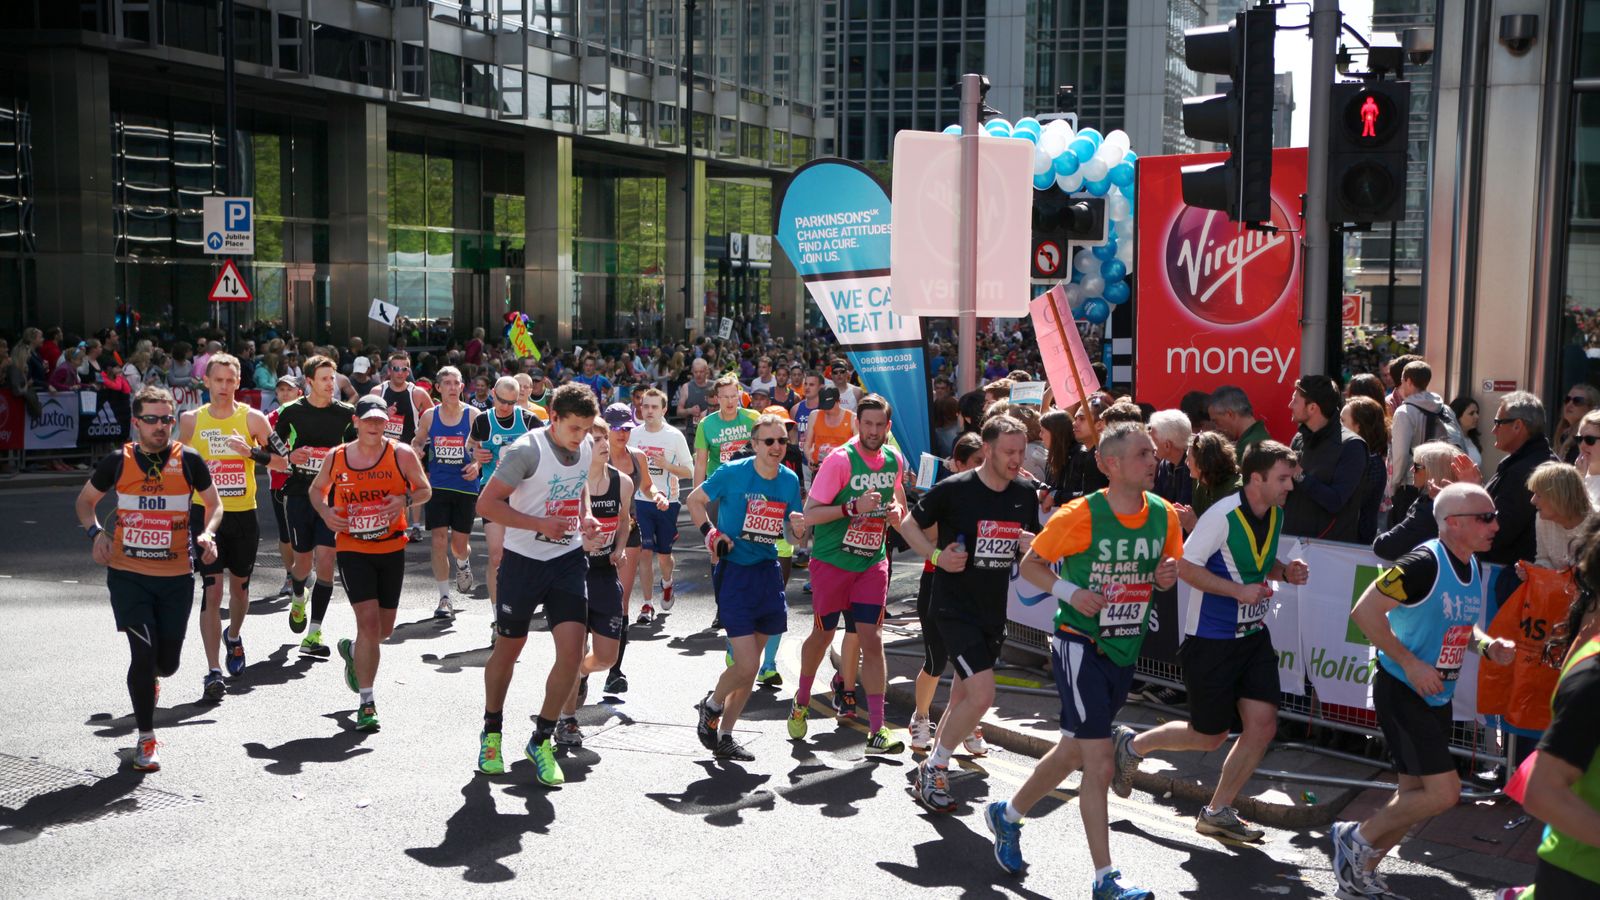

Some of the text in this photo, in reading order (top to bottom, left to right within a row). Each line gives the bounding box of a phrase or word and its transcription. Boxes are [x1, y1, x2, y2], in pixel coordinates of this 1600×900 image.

[229, 203, 246, 229] P
[795, 211, 871, 229] PARKINSON'S
[797, 228, 839, 241] CHANGE
[799, 238, 860, 253] FIND A CURE.
[800, 251, 841, 264] JOIN US.
[1177, 209, 1286, 305] Virgin
[830, 288, 863, 310] WE
[837, 311, 882, 333] BEAT
[1167, 345, 1296, 384] money
[88, 424, 122, 436] adidas
[719, 425, 748, 437] JOHN
[435, 447, 463, 456] 23724
[211, 473, 245, 486] 8895
[138, 495, 167, 510] Rob
[144, 518, 170, 527] money
[350, 515, 388, 530] 43725
[745, 515, 783, 533] 38035
[998, 526, 1021, 534] money
[125, 529, 170, 546] 47695
[845, 530, 882, 547] 55053
[976, 538, 1018, 555] 24224
[1098, 537, 1164, 561] SEAN
[1091, 561, 1139, 573] WE ARE
[1089, 571, 1155, 585] MACMILLA
[1107, 603, 1141, 621] 4443
